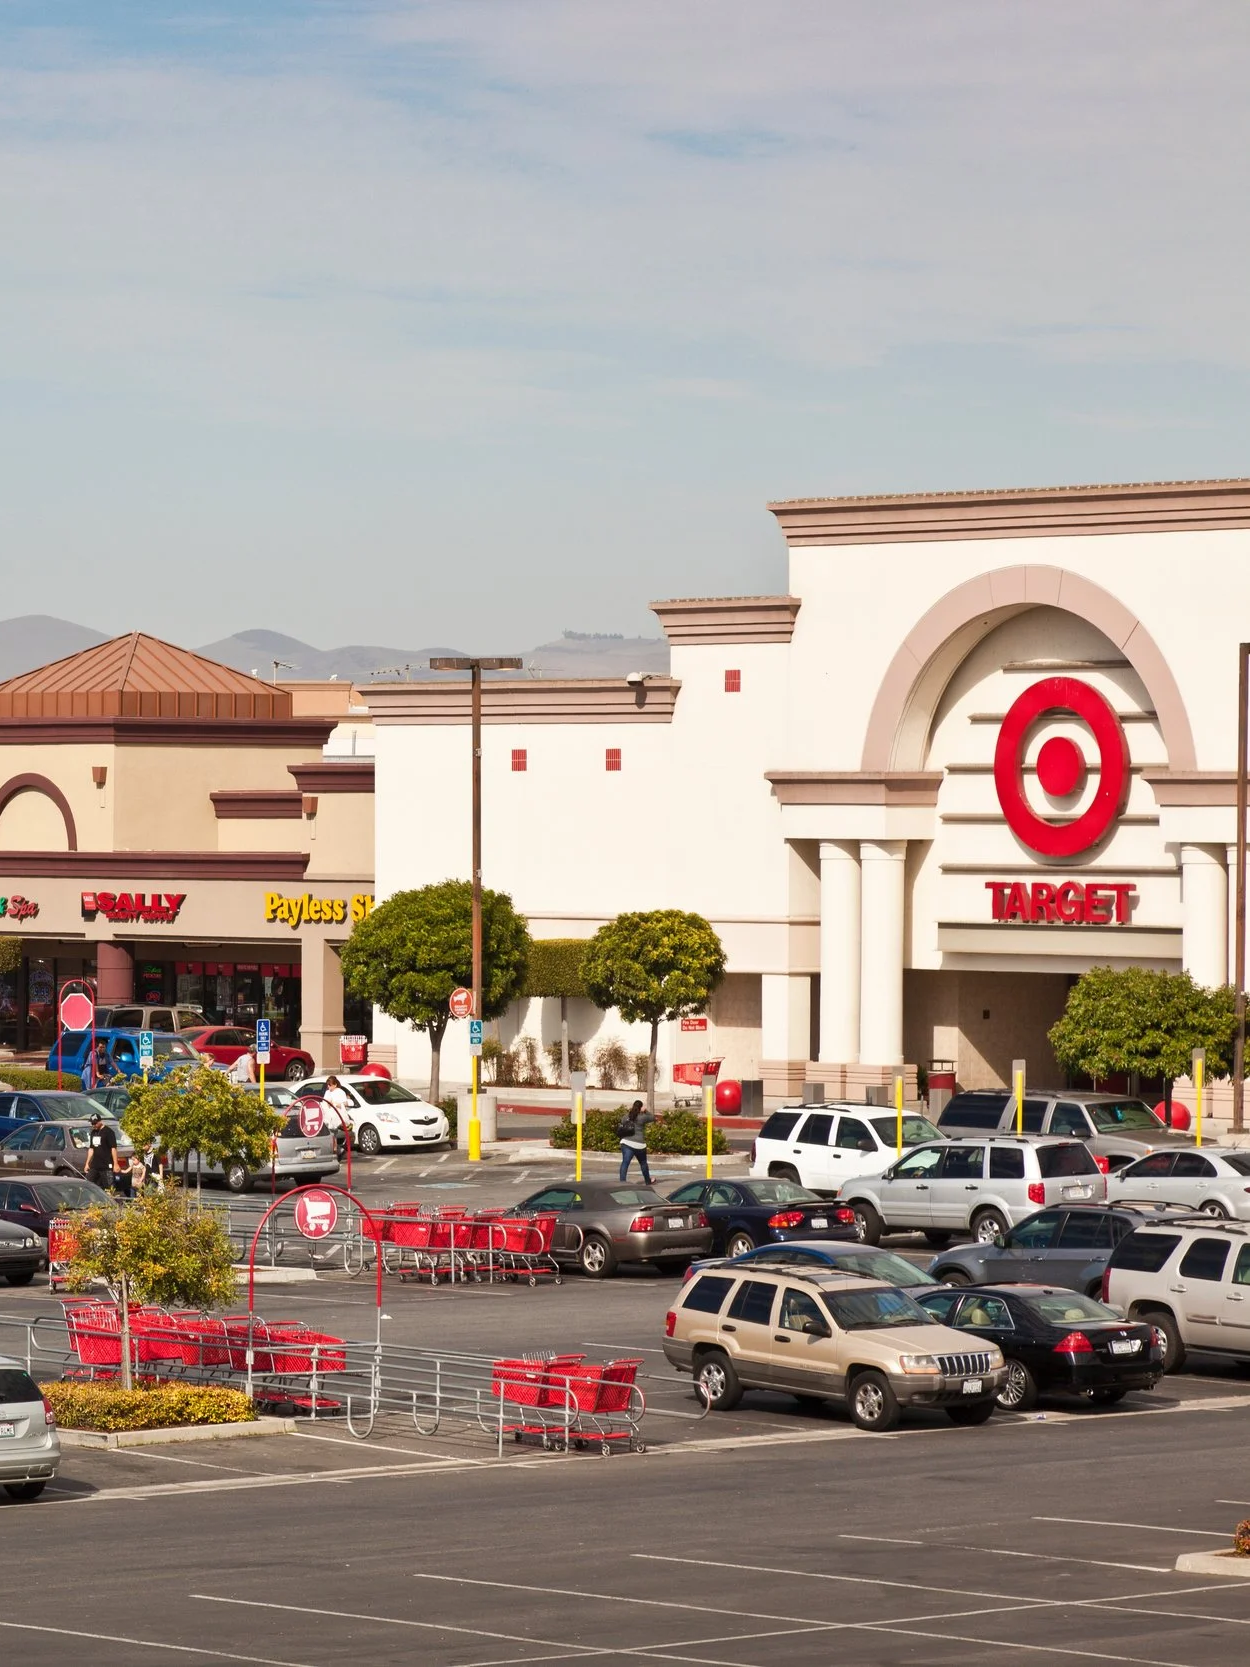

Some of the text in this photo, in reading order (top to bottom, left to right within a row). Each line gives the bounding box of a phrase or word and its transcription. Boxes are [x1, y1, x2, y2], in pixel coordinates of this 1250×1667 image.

[7, 895, 39, 920] Spa
[96, 892, 186, 912] SALLY
[264, 892, 344, 926] Payless
[985, 880, 1138, 924] TARGET
